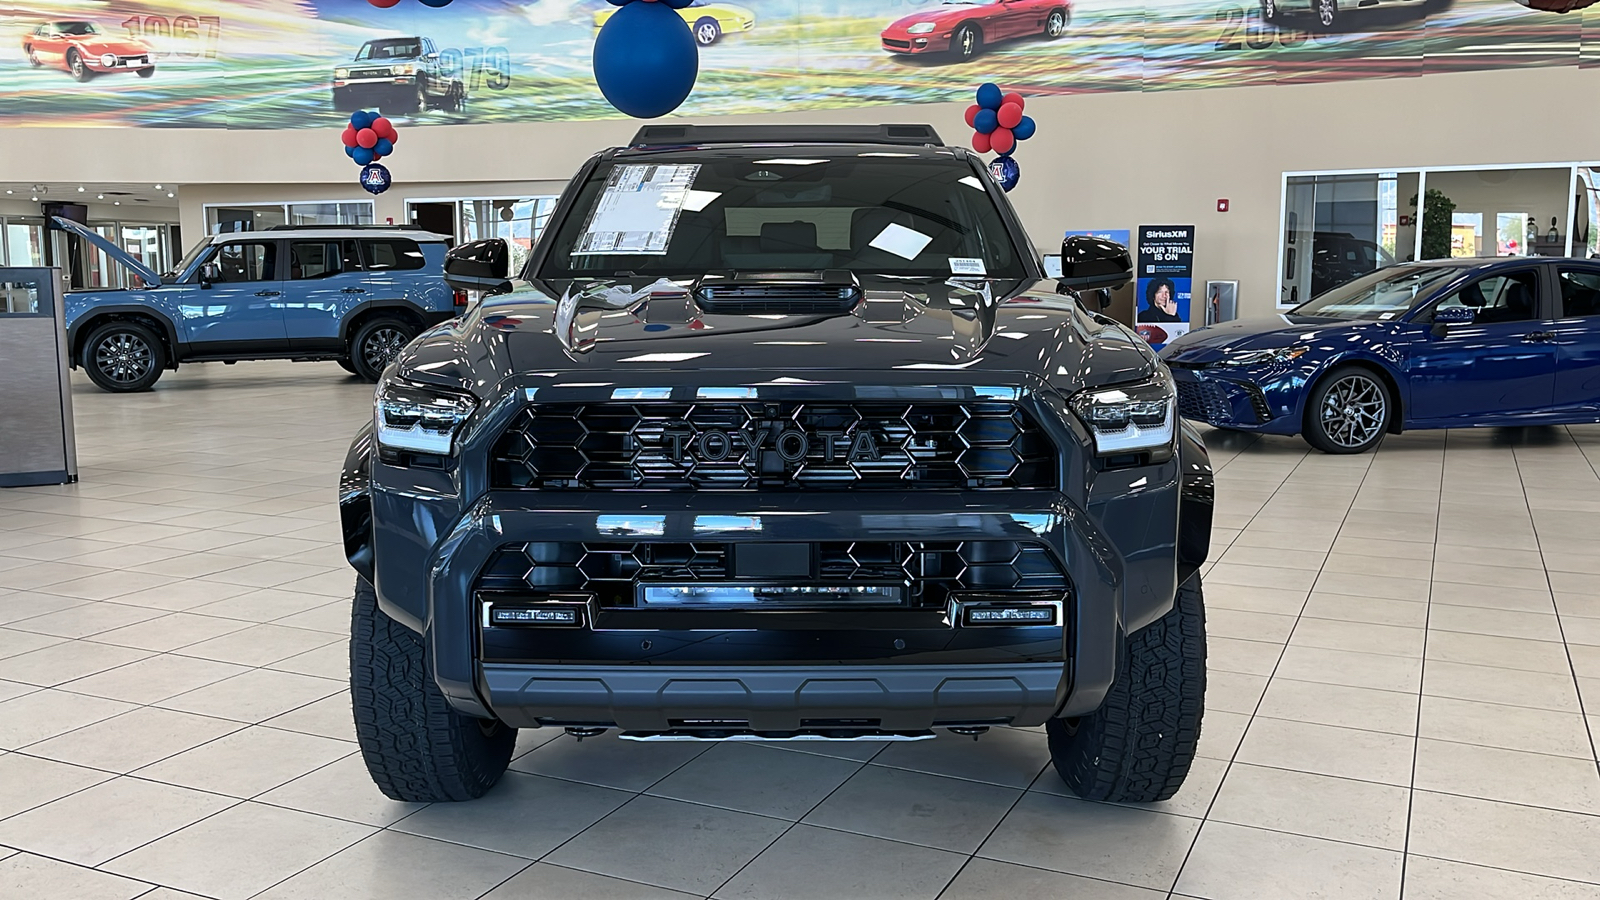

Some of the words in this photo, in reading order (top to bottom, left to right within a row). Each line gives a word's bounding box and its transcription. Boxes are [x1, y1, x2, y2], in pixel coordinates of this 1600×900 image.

[1140, 246, 1165, 254] YOUR
[1166, 246, 1192, 254] TRIAL
[664, 429, 881, 462] TOYOTA
